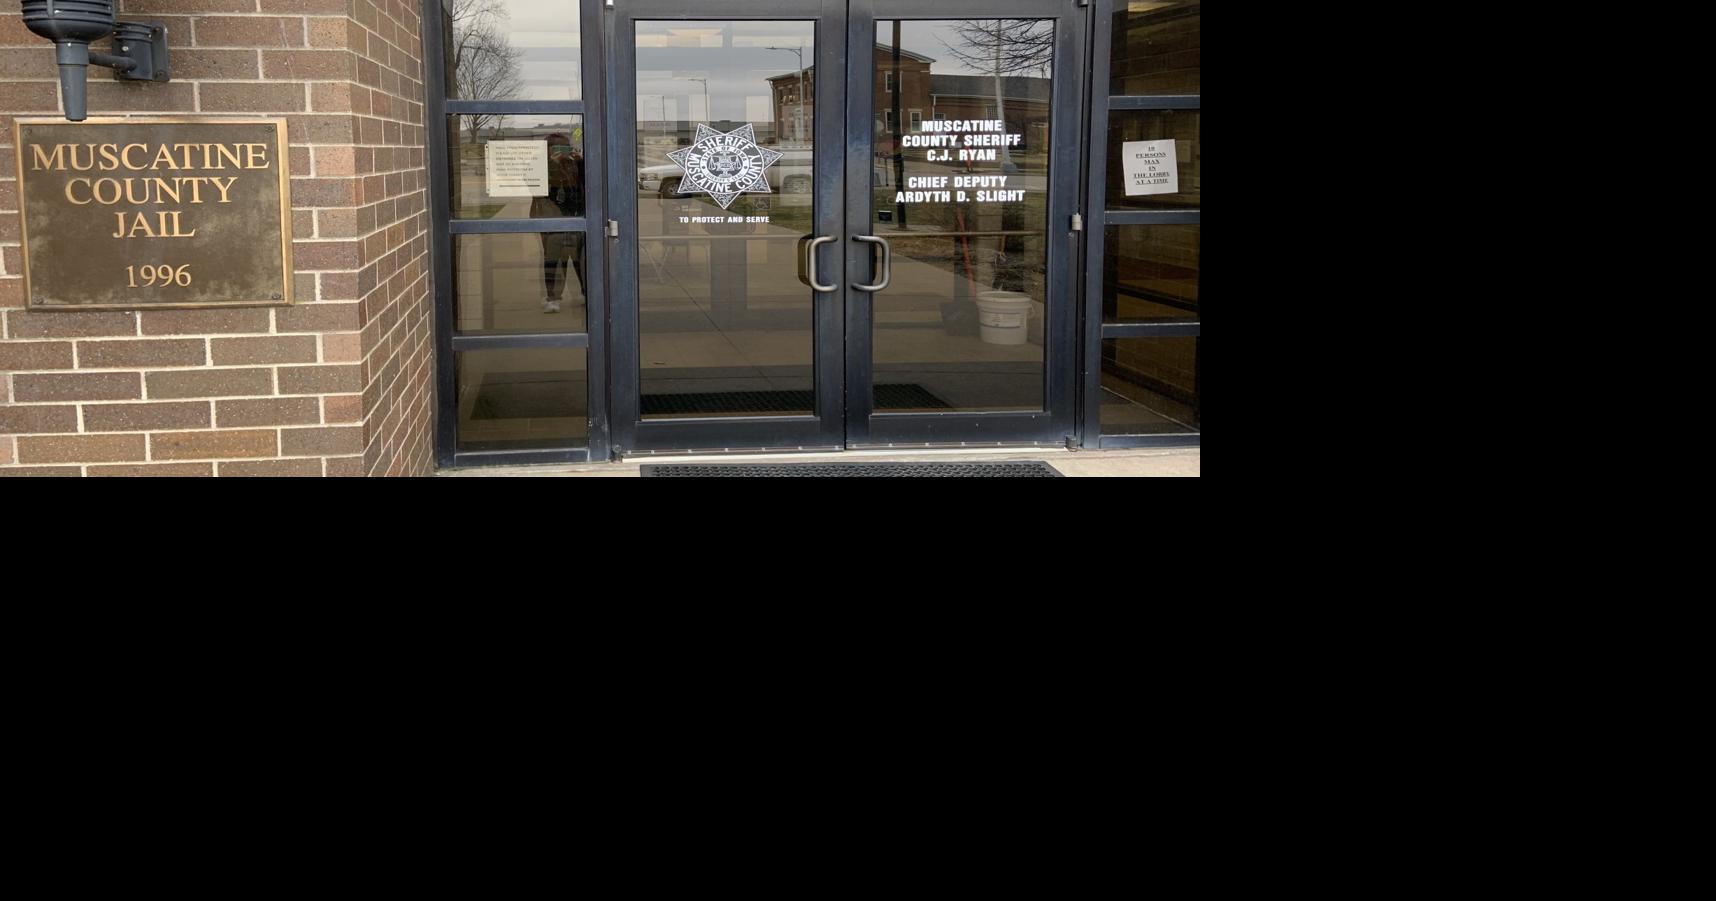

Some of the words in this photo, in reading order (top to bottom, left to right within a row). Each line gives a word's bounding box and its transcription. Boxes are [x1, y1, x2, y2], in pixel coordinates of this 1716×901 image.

[922, 120, 1002, 132] MUSCATINE
[697, 136, 753, 152] SHERIFF
[902, 135, 958, 147] COUNTY
[964, 134, 1021, 146] SHERIFF
[30, 143, 270, 171] MUSCATINE
[927, 149, 953, 161] C.J.
[959, 149, 996, 161] RYAN
[687, 152, 732, 193] MUSCATINE
[735, 154, 762, 189] COUNTY
[908, 176, 948, 188] CHIEF
[954, 176, 1007, 188] DEPUTY
[65, 177, 238, 205] COUNTY
[895, 191, 950, 203] ARDYTH
[956, 191, 970, 202] D.
[976, 190, 1026, 202] SLIGHT
[112, 210, 196, 239] JAIL
[125, 263, 192, 288] 1996
